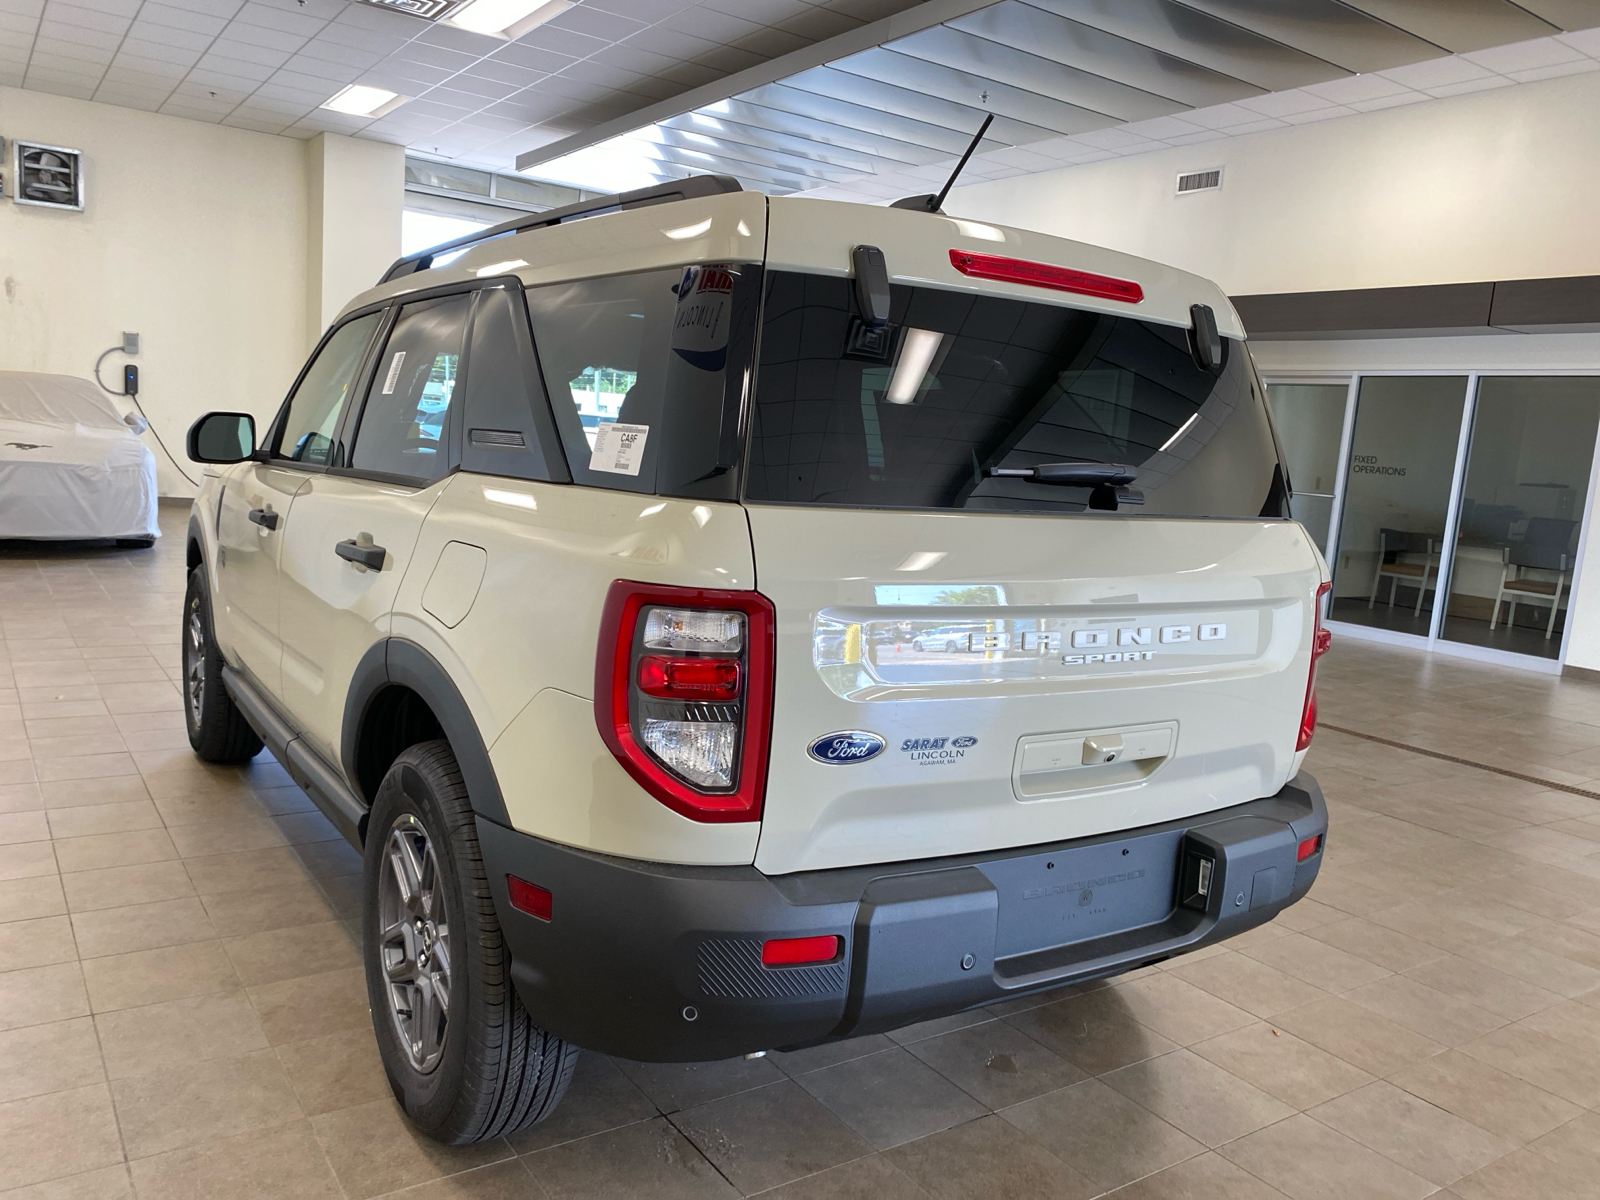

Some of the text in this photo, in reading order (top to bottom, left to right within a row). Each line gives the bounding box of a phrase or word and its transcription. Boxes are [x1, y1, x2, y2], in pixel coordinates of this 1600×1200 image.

[1353, 455, 1378, 465] FIXED
[1353, 465, 1406, 476] OPERATIONS
[968, 623, 1227, 651] BRONCO
[1062, 651, 1157, 666] SPORT
[900, 737, 950, 752] SARAT
[910, 750, 965, 760] LINCOLN
[1022, 868, 1146, 901] BRONCO
